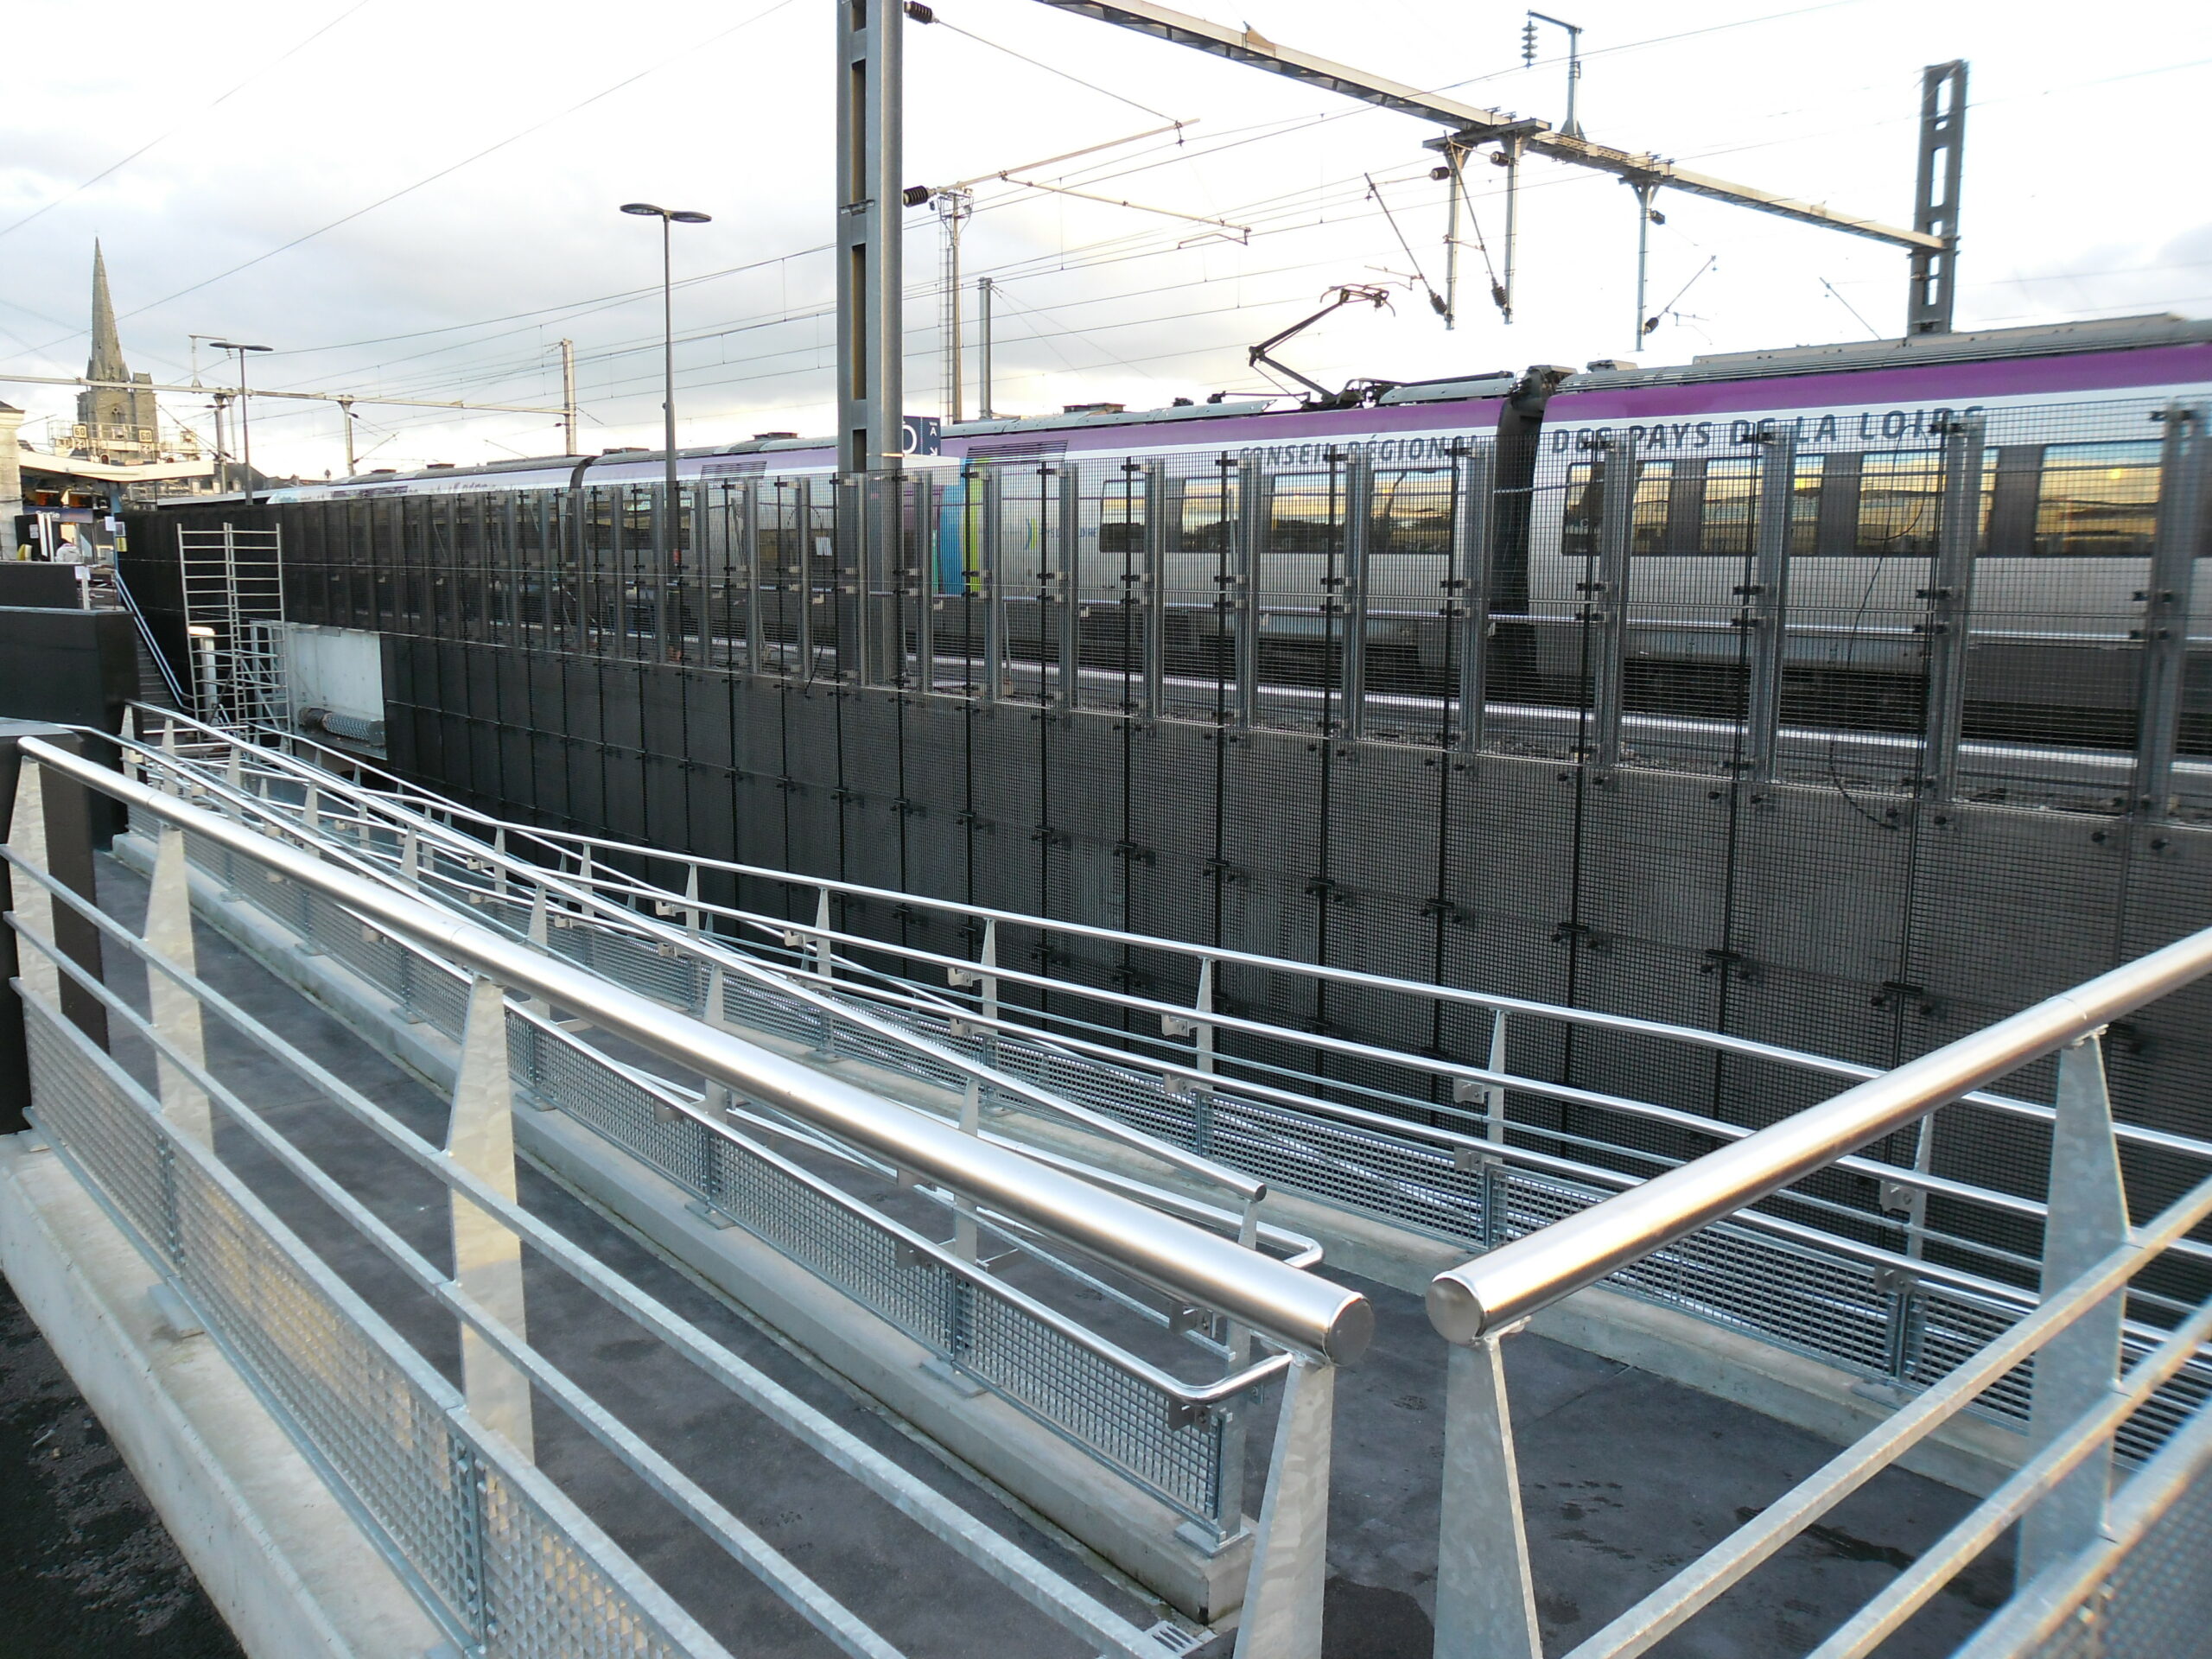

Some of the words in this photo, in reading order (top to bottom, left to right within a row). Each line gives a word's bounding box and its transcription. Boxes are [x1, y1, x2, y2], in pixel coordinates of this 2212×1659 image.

[929, 426, 938, 436] A
[1629, 421, 1713, 451] PAYS
[1794, 414, 1837, 444] LA
